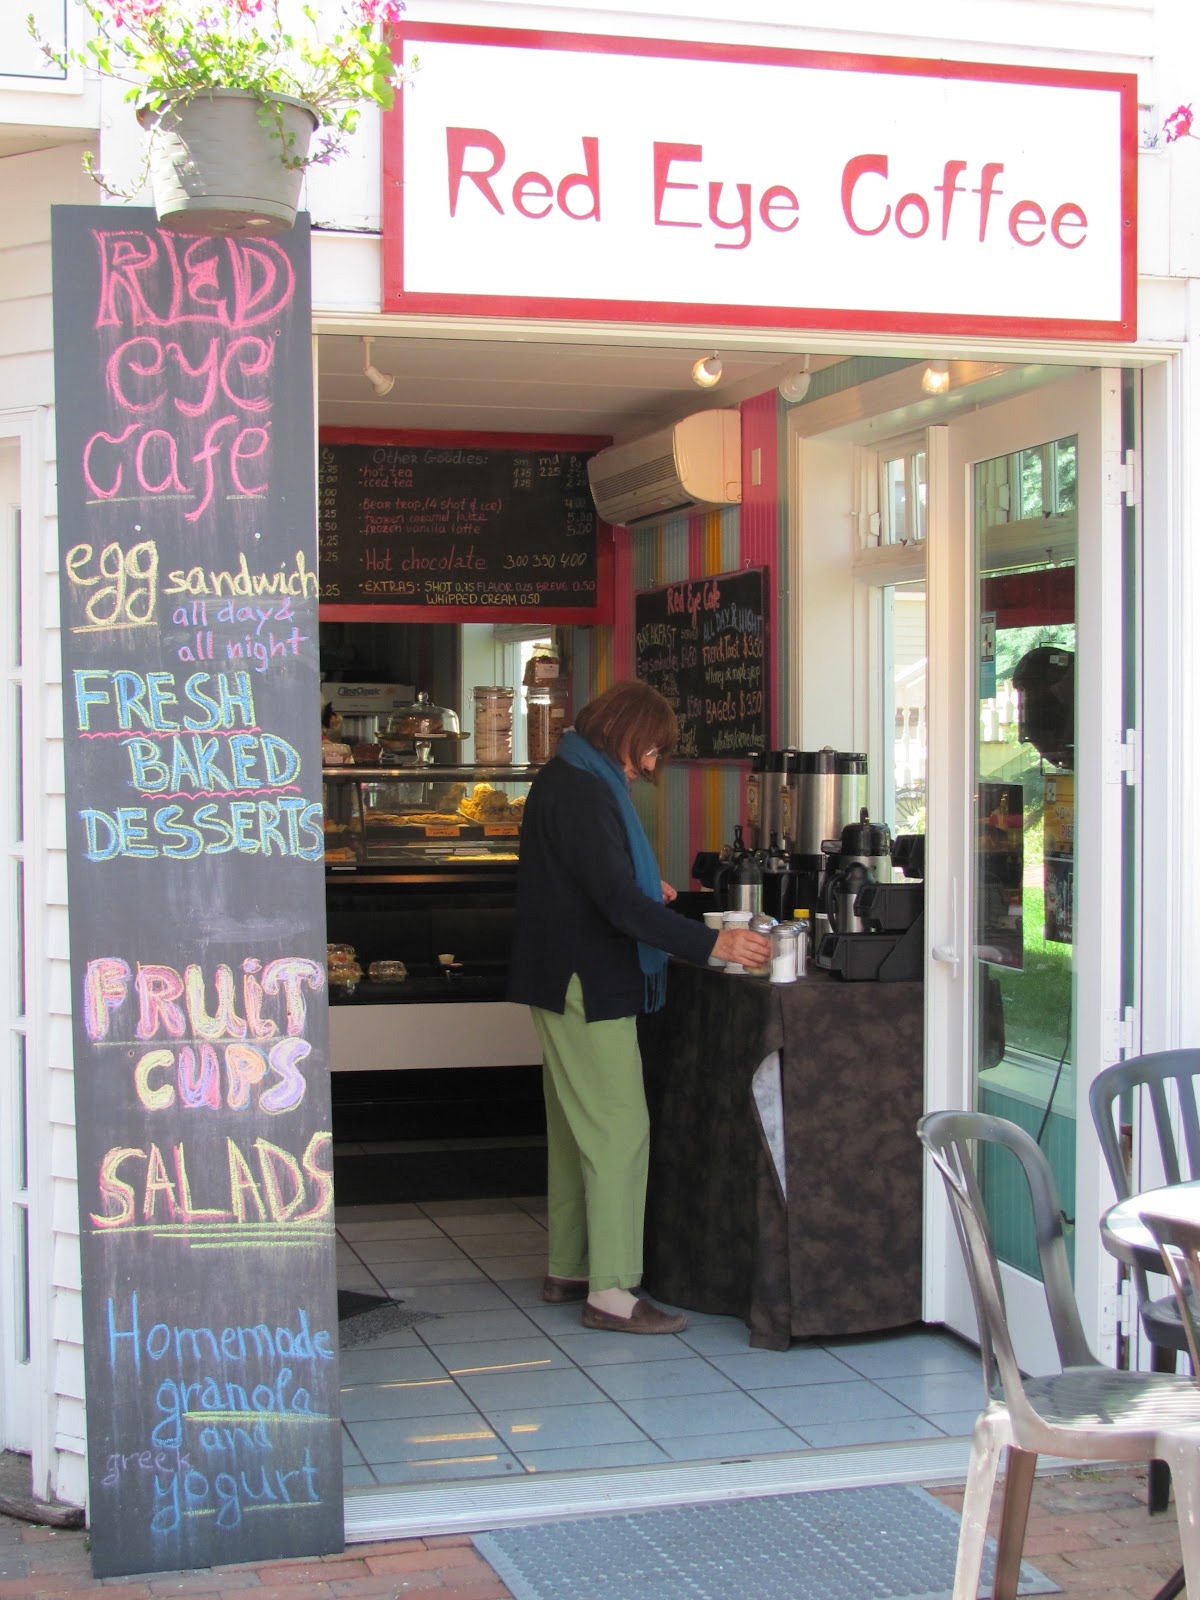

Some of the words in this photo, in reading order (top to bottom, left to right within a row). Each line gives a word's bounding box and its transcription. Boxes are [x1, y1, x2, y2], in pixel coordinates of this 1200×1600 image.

[446, 126, 600, 222] Red
[653, 141, 800, 249] Eye
[841, 153, 1088, 249] Coffee
[90, 227, 296, 330] RED
[83, 414, 273, 521] cafe
[364, 476, 389, 488] iced
[392, 476, 413, 487] tea
[390, 465, 413, 477] tea
[65, 540, 159, 626] egg
[163, 550, 318, 602] sandwich
[366, 547, 392, 570] Hot
[402, 544, 487, 570] chocolate
[425, 581, 452, 592] SHOT
[477, 582, 513, 592] FLAVOR
[172, 600, 208, 627] all
[217, 599, 273, 636] day
[481, 593, 517, 605] CREAM
[178, 630, 213, 662] all
[227, 627, 310, 673] night
[73, 669, 257, 734] FRESH
[121, 734, 301, 793] BAKED
[81, 797, 325, 862] DESSERTS
[135, 1037, 312, 1114] CUPS
[89, 1130, 335, 1228] SALADS
[106, 1290, 335, 1370] Homemade
[152, 1367, 320, 1449] granola
[199, 1422, 273, 1458] and
[102, 1450, 193, 1486] greek
[150, 1448, 319, 1533] yogurt
